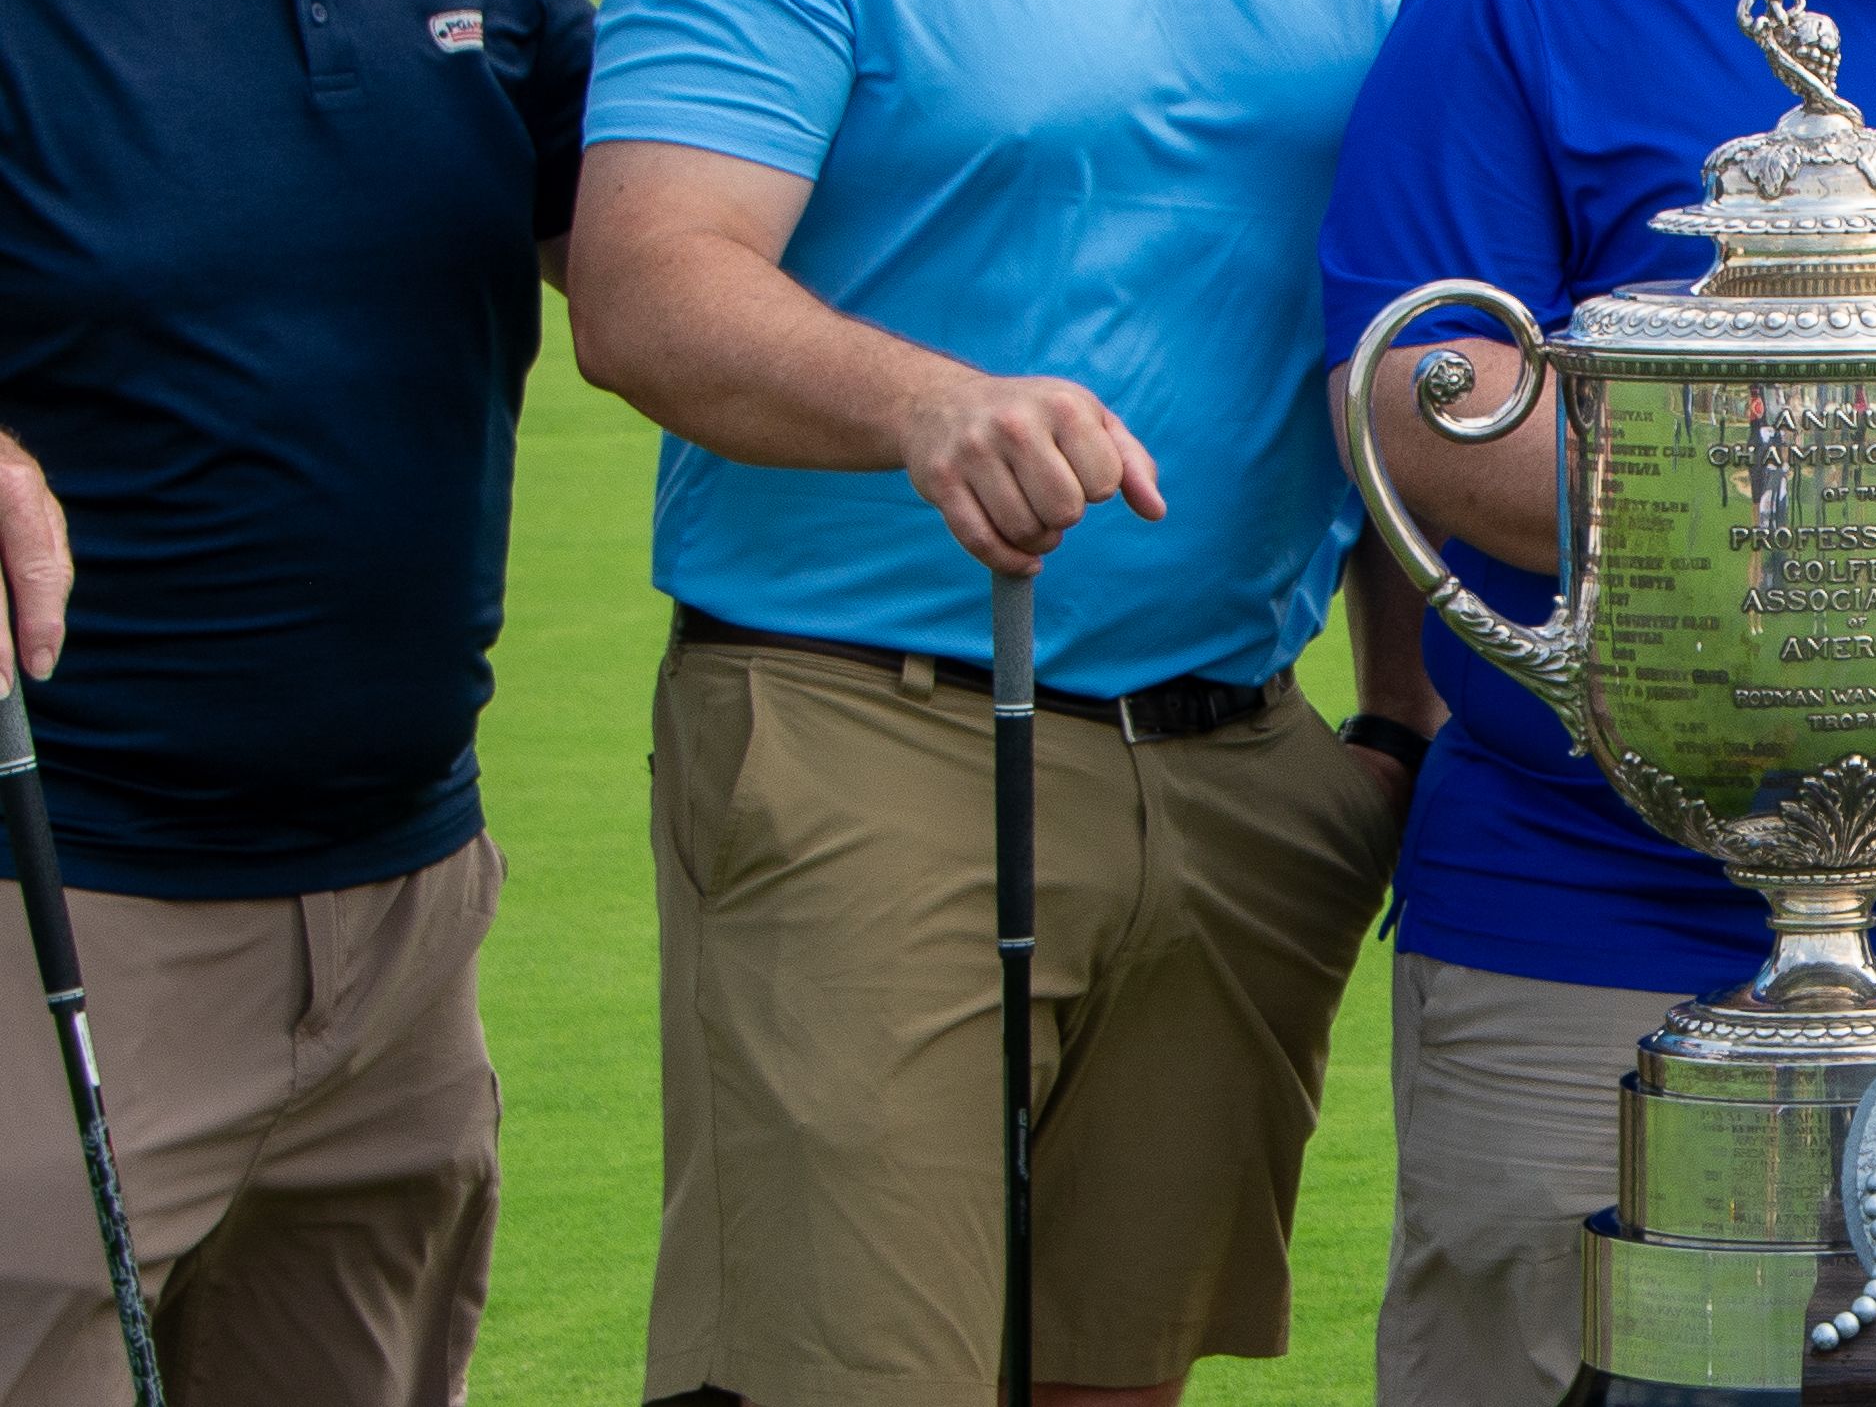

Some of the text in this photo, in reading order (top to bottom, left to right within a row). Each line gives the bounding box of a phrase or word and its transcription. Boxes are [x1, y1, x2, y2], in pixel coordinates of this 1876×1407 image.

[1822, 487, 1850, 502] OF
[1847, 615, 1868, 629] OF
[1734, 688, 1826, 709] RODMAN
